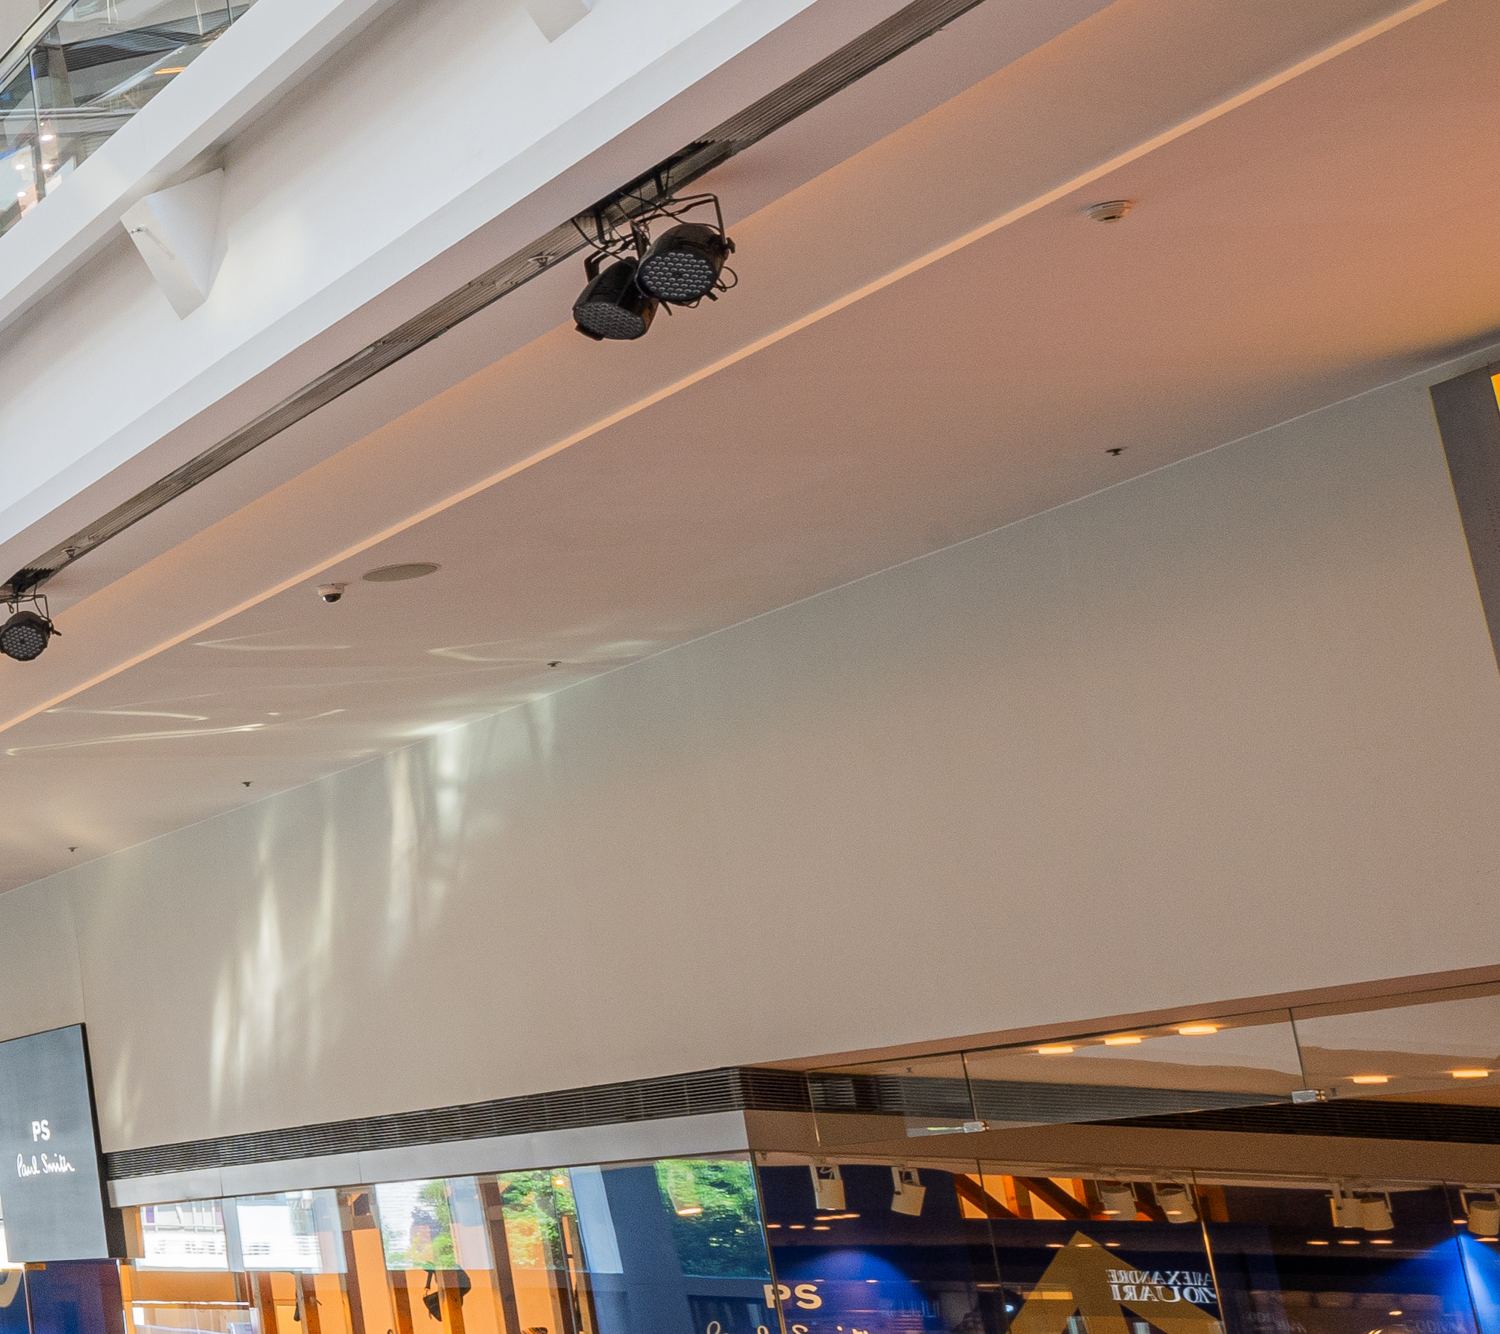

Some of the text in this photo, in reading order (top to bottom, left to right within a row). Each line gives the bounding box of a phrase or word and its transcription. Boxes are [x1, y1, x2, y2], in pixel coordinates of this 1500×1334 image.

[32, 1120, 51, 1142] PS
[17, 1153, 75, 1178] Paul Smith
[763, 1284, 823, 1310] PS
